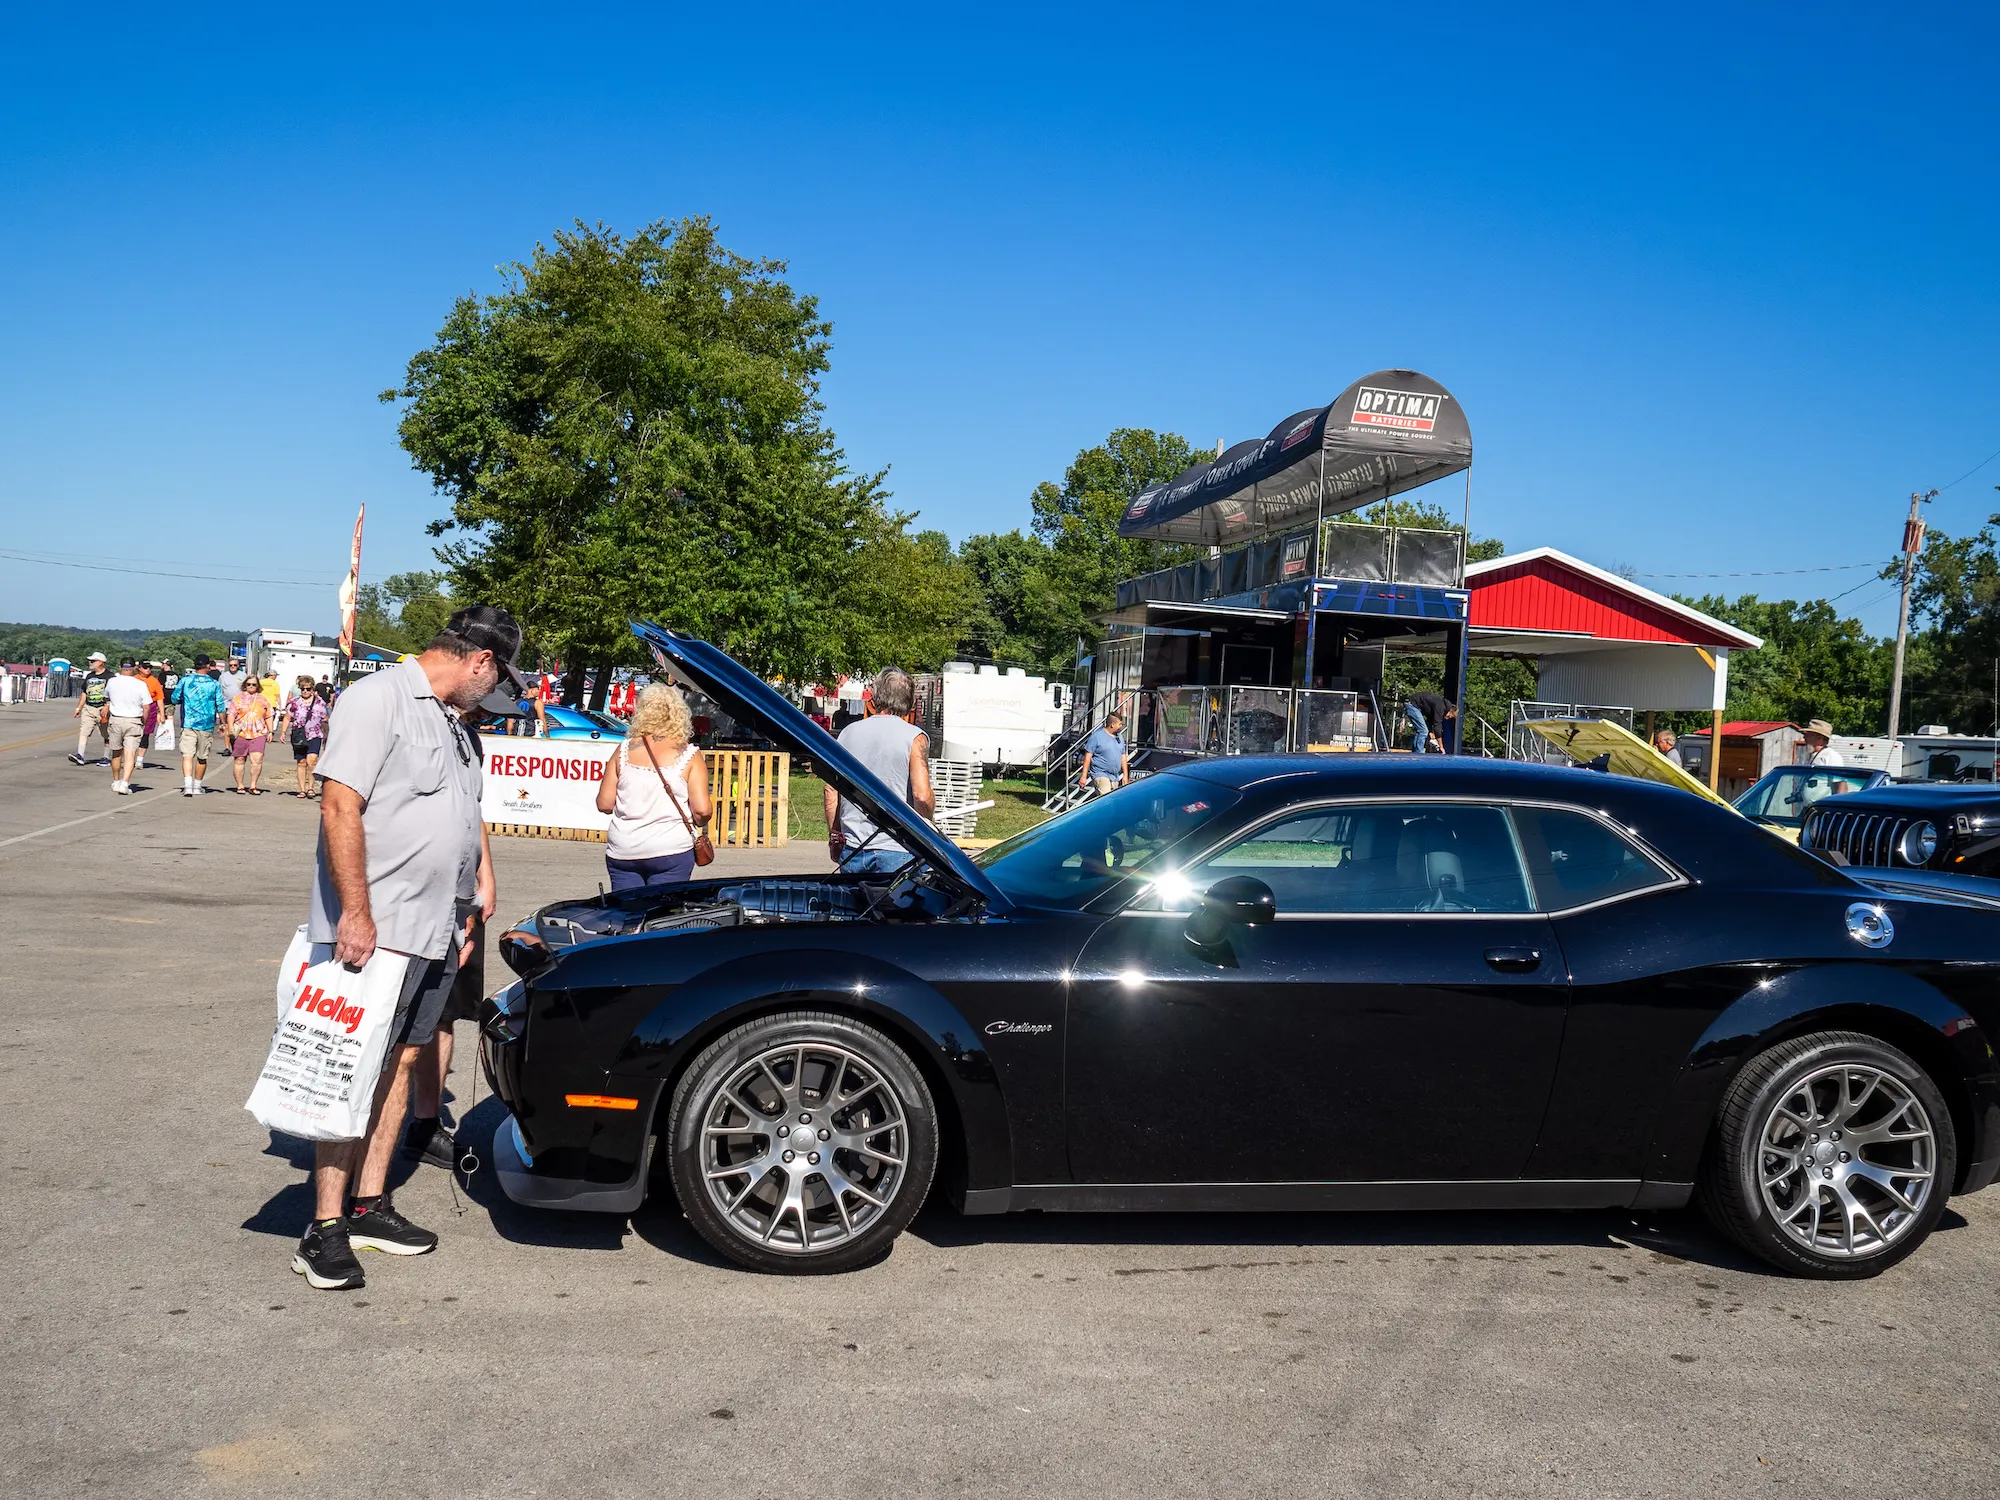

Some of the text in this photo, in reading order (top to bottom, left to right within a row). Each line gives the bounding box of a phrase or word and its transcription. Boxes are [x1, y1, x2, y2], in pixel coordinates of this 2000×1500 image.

[1359, 391, 1435, 417] OPTIMA
[1370, 415, 1418, 428] BATTERIES
[1360, 427, 1387, 435] ULTIMATE
[1389, 430, 1409, 438] POWER
[1411, 432, 1433, 440] SOURCE
[352, 662, 374, 670] ATM
[502, 800, 518, 808] Smith
[520, 801, 543, 810] Brothers
[285, 1021, 307, 1031] MSD
[984, 1020, 1053, 1035] Challenger
[341, 1073, 354, 1083] HK
